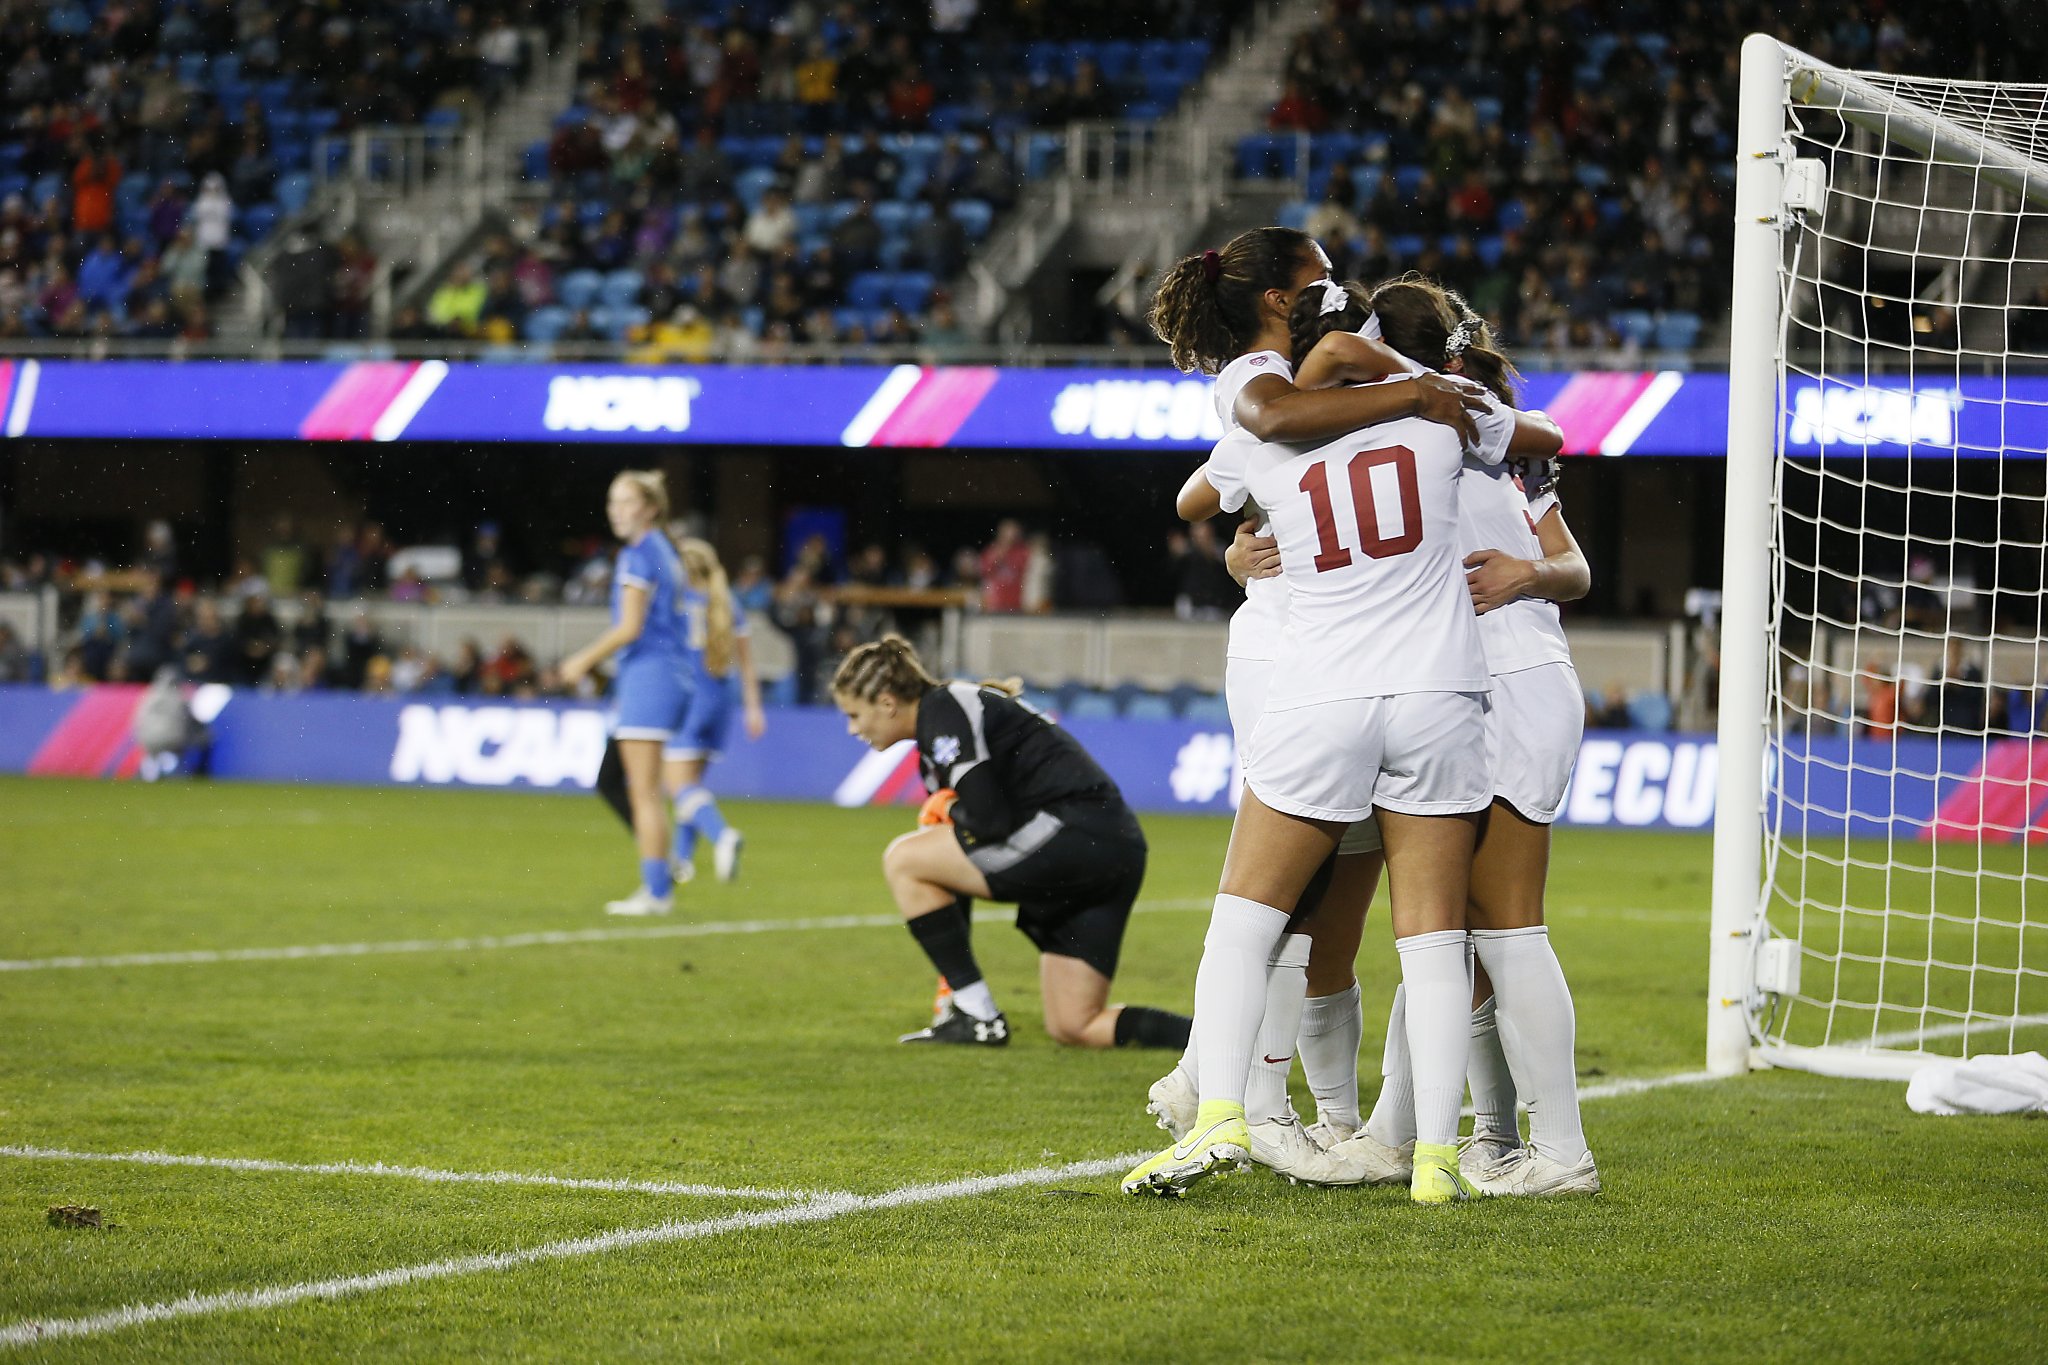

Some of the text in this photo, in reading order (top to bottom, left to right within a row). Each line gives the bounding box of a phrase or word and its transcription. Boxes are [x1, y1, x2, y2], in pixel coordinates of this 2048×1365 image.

[543, 375, 690, 432] NCAA
[1790, 387, 1952, 445] NCAA
[1298, 444, 1424, 573] 10
[390, 704, 607, 788] NCAA
